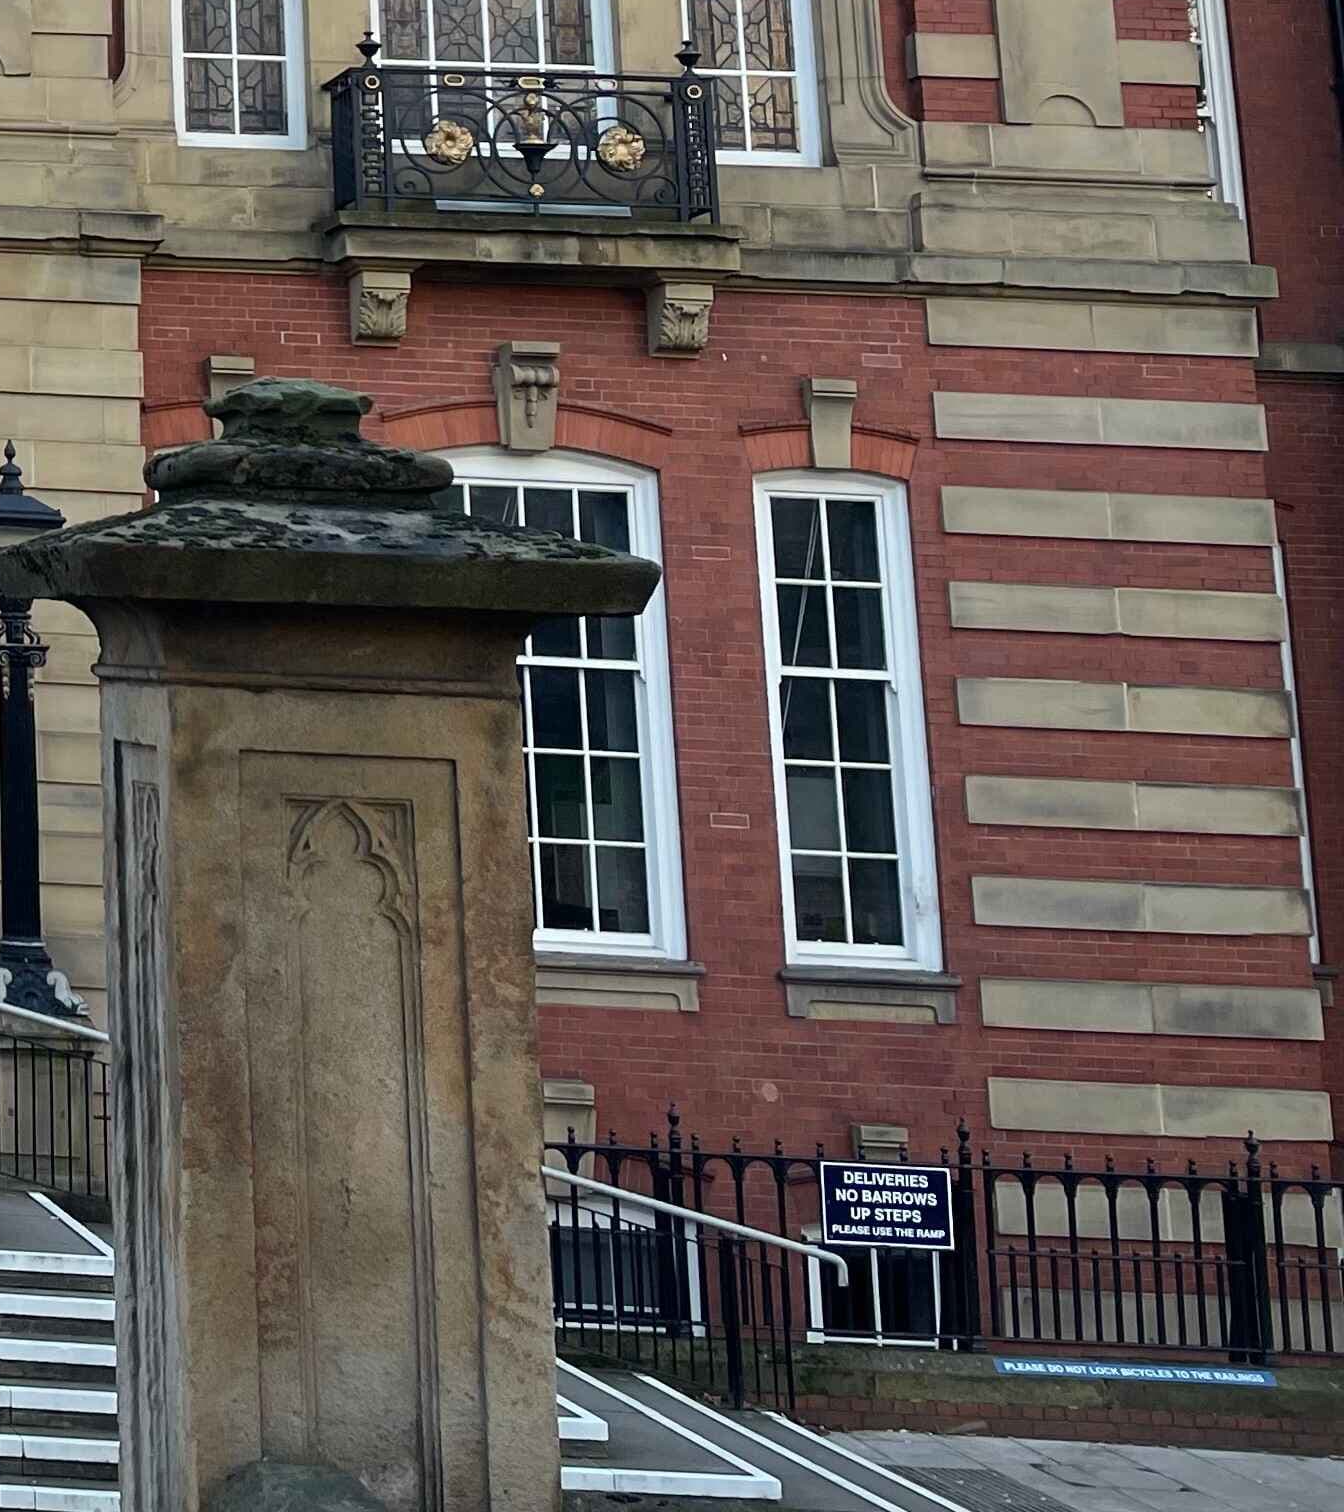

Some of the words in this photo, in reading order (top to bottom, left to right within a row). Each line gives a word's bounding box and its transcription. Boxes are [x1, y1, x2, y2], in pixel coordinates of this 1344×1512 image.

[843, 1171, 929, 1188] DELIVERIES
[835, 1188, 858, 1202] NO
[862, 1189, 938, 1207] BARROWS
[850, 1207, 871, 1220] UP
[874, 1208, 922, 1223] STEPS
[832, 1224, 871, 1235] PLEASE
[872, 1226, 893, 1236] USE
[894, 1227, 915, 1238] THE
[916, 1228, 946, 1239] RAMP
[1003, 1361, 1047, 1372] PLEASE
[1047, 1364, 1064, 1373] DO
[1065, 1365, 1087, 1374] NOT
[1089, 1366, 1120, 1376] LOCK
[1120, 1367, 1173, 1378] BICYCLES
[1173, 1370, 1190, 1379] TO
[1191, 1370, 1213, 1380] THE
[1214, 1372, 1265, 1383] RAILINGS
